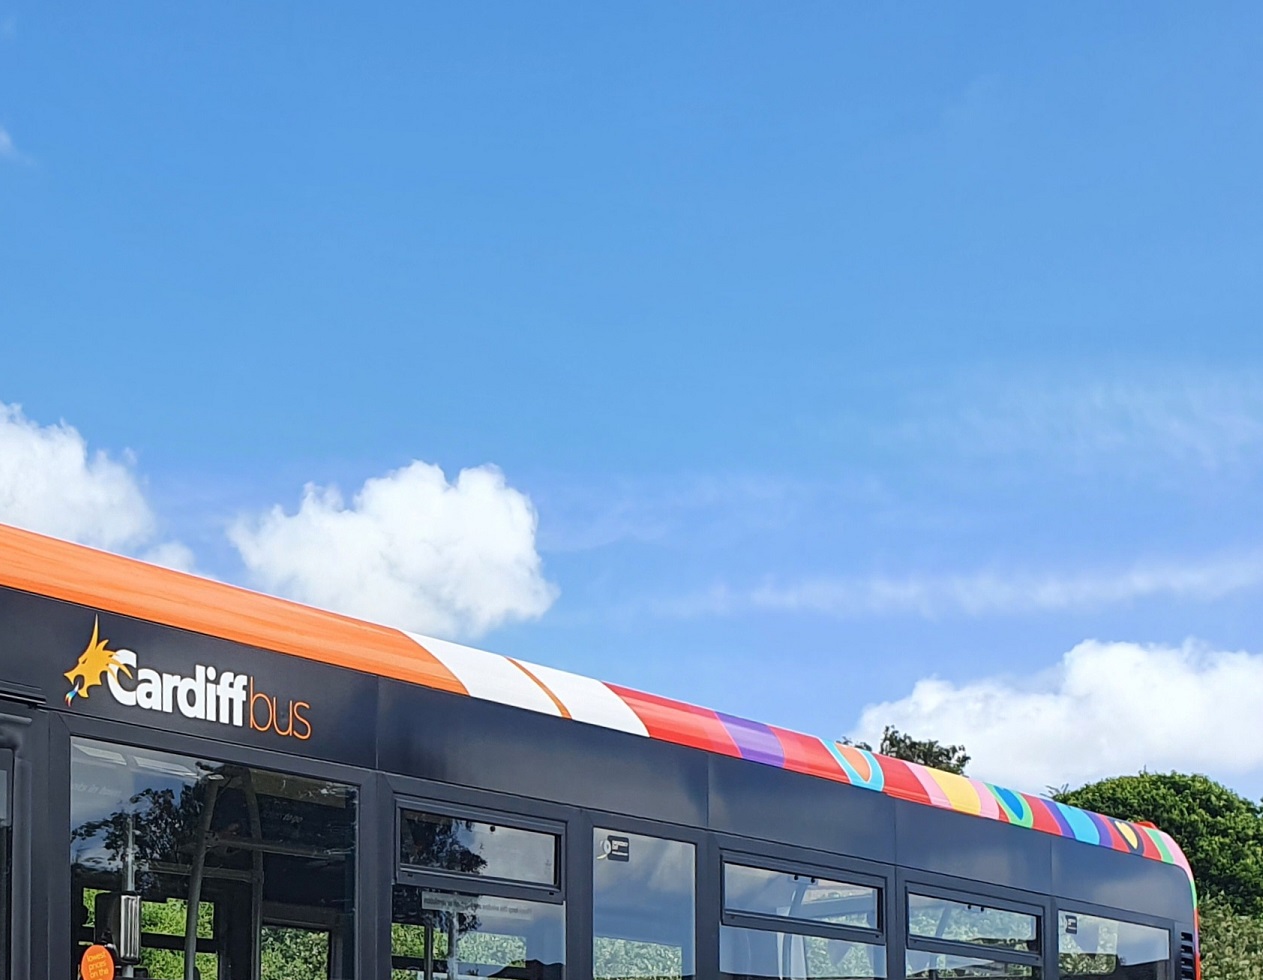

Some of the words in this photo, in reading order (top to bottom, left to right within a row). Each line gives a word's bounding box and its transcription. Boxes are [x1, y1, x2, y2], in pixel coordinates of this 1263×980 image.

[250, 676, 312, 740] bus
[86, 951, 107, 962] lowest
[88, 961, 107, 971] prices
[90, 971, 98, 979] on
[98, 968, 109, 976] the
